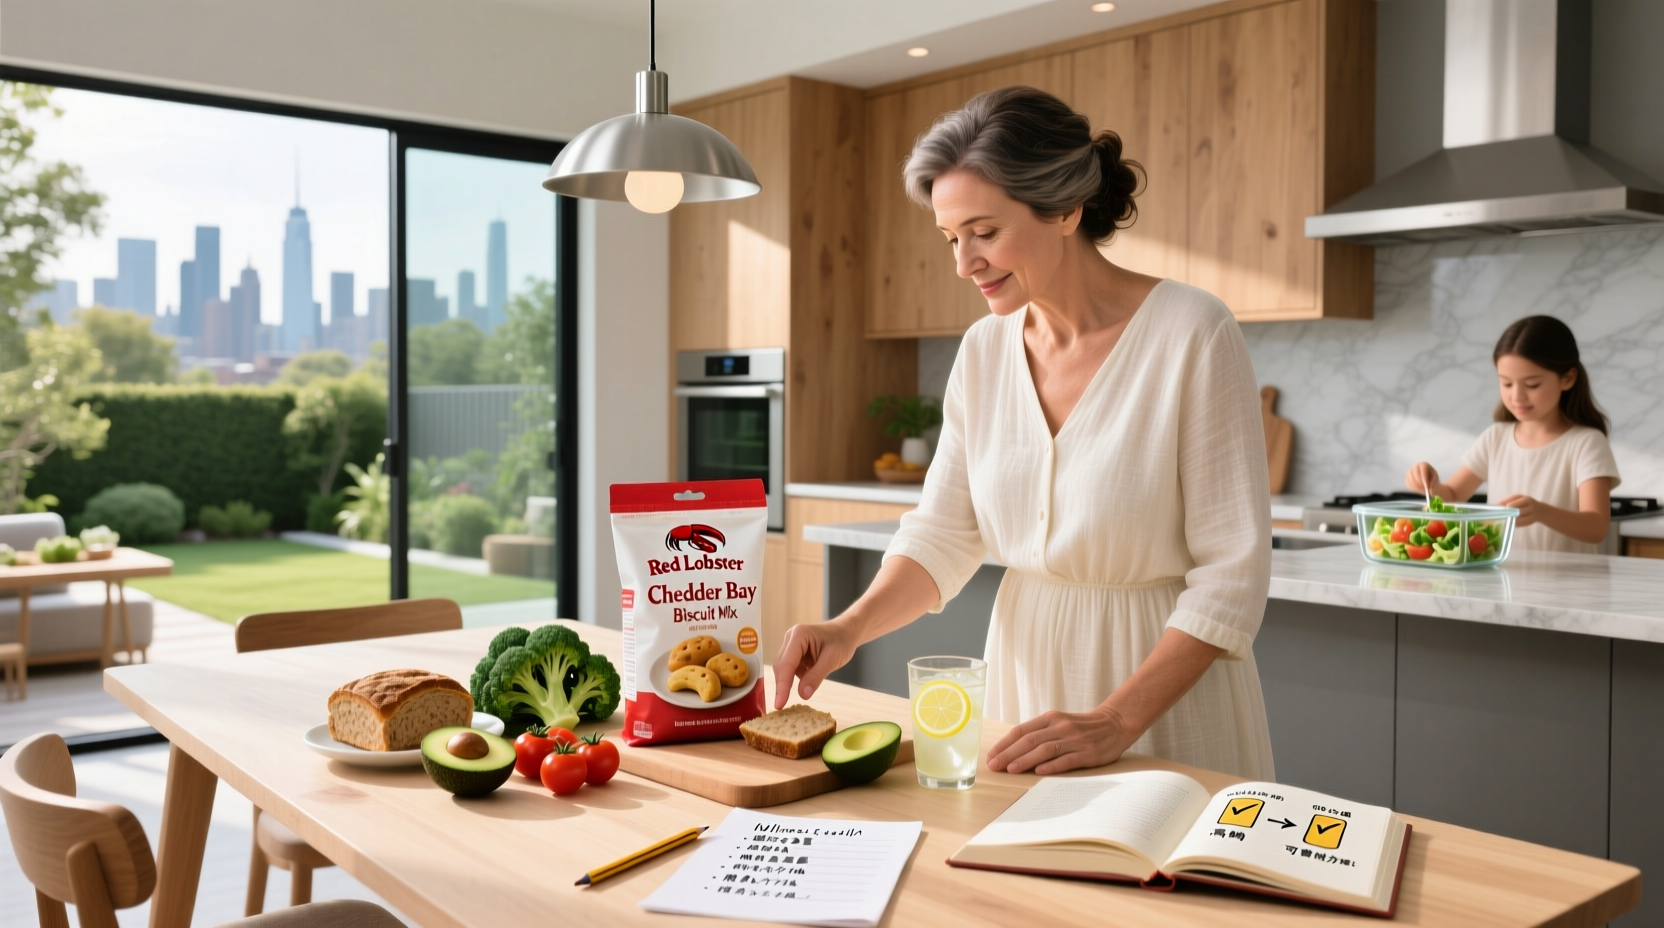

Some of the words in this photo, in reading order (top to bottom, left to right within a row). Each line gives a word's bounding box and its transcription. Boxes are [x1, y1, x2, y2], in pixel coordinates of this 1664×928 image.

[647, 555, 682, 577] Red
[683, 553, 744, 571] Lobster
[647, 582, 723, 605] Chedder
[725, 581, 757, 606] Bay
[673, 605, 716, 623] Biscuit
